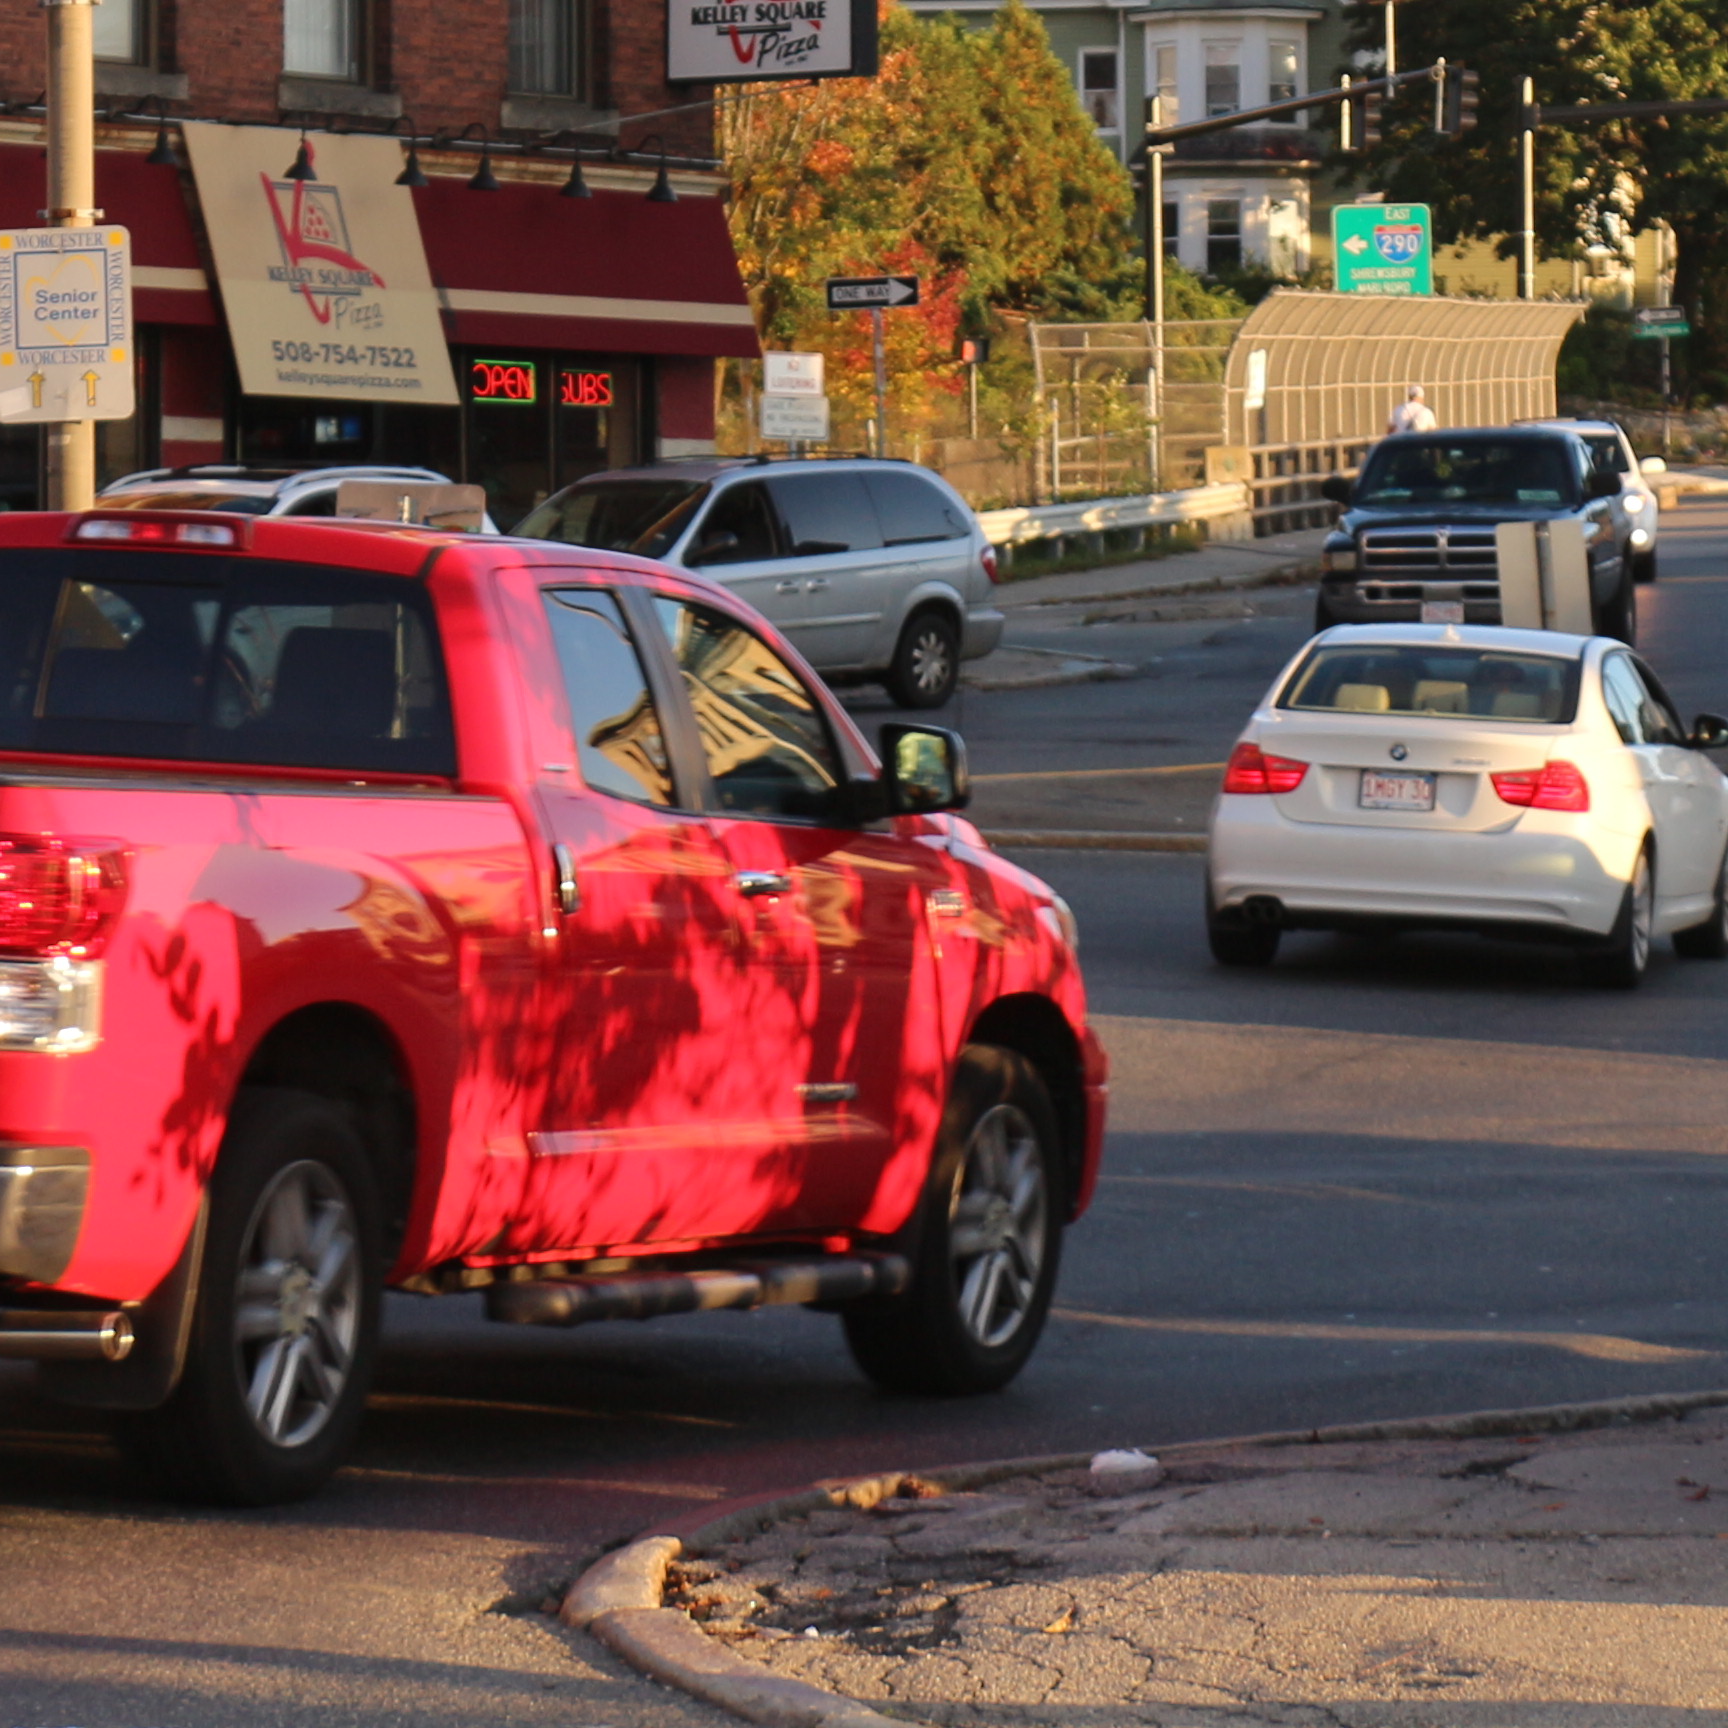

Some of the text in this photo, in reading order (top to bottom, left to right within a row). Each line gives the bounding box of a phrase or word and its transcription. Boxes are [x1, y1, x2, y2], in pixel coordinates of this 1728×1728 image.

[691, 0, 827, 25] KELLEY SQUARE
[756, 31, 821, 68] Pizza
[1384, 206, 1411, 221] EAST
[15, 232, 104, 251] WORCESTER
[1381, 234, 1418, 253] 290
[268, 266, 314, 283] KELLEY
[35, 288, 98, 305] Senior
[109, 250, 124, 342] WORCESTER
[835, 285, 891, 300] ONE WAY
[34, 306, 99, 322] Center
[334, 295, 384, 330] Pizza
[17, 349, 106, 366] WORCESTER
[273, 340, 418, 369] 508-754-7522
[277, 369, 422, 390] kelleysquarepizza.com
[473, 363, 535, 399] OPEN
[561, 373, 614, 406] SUBS
